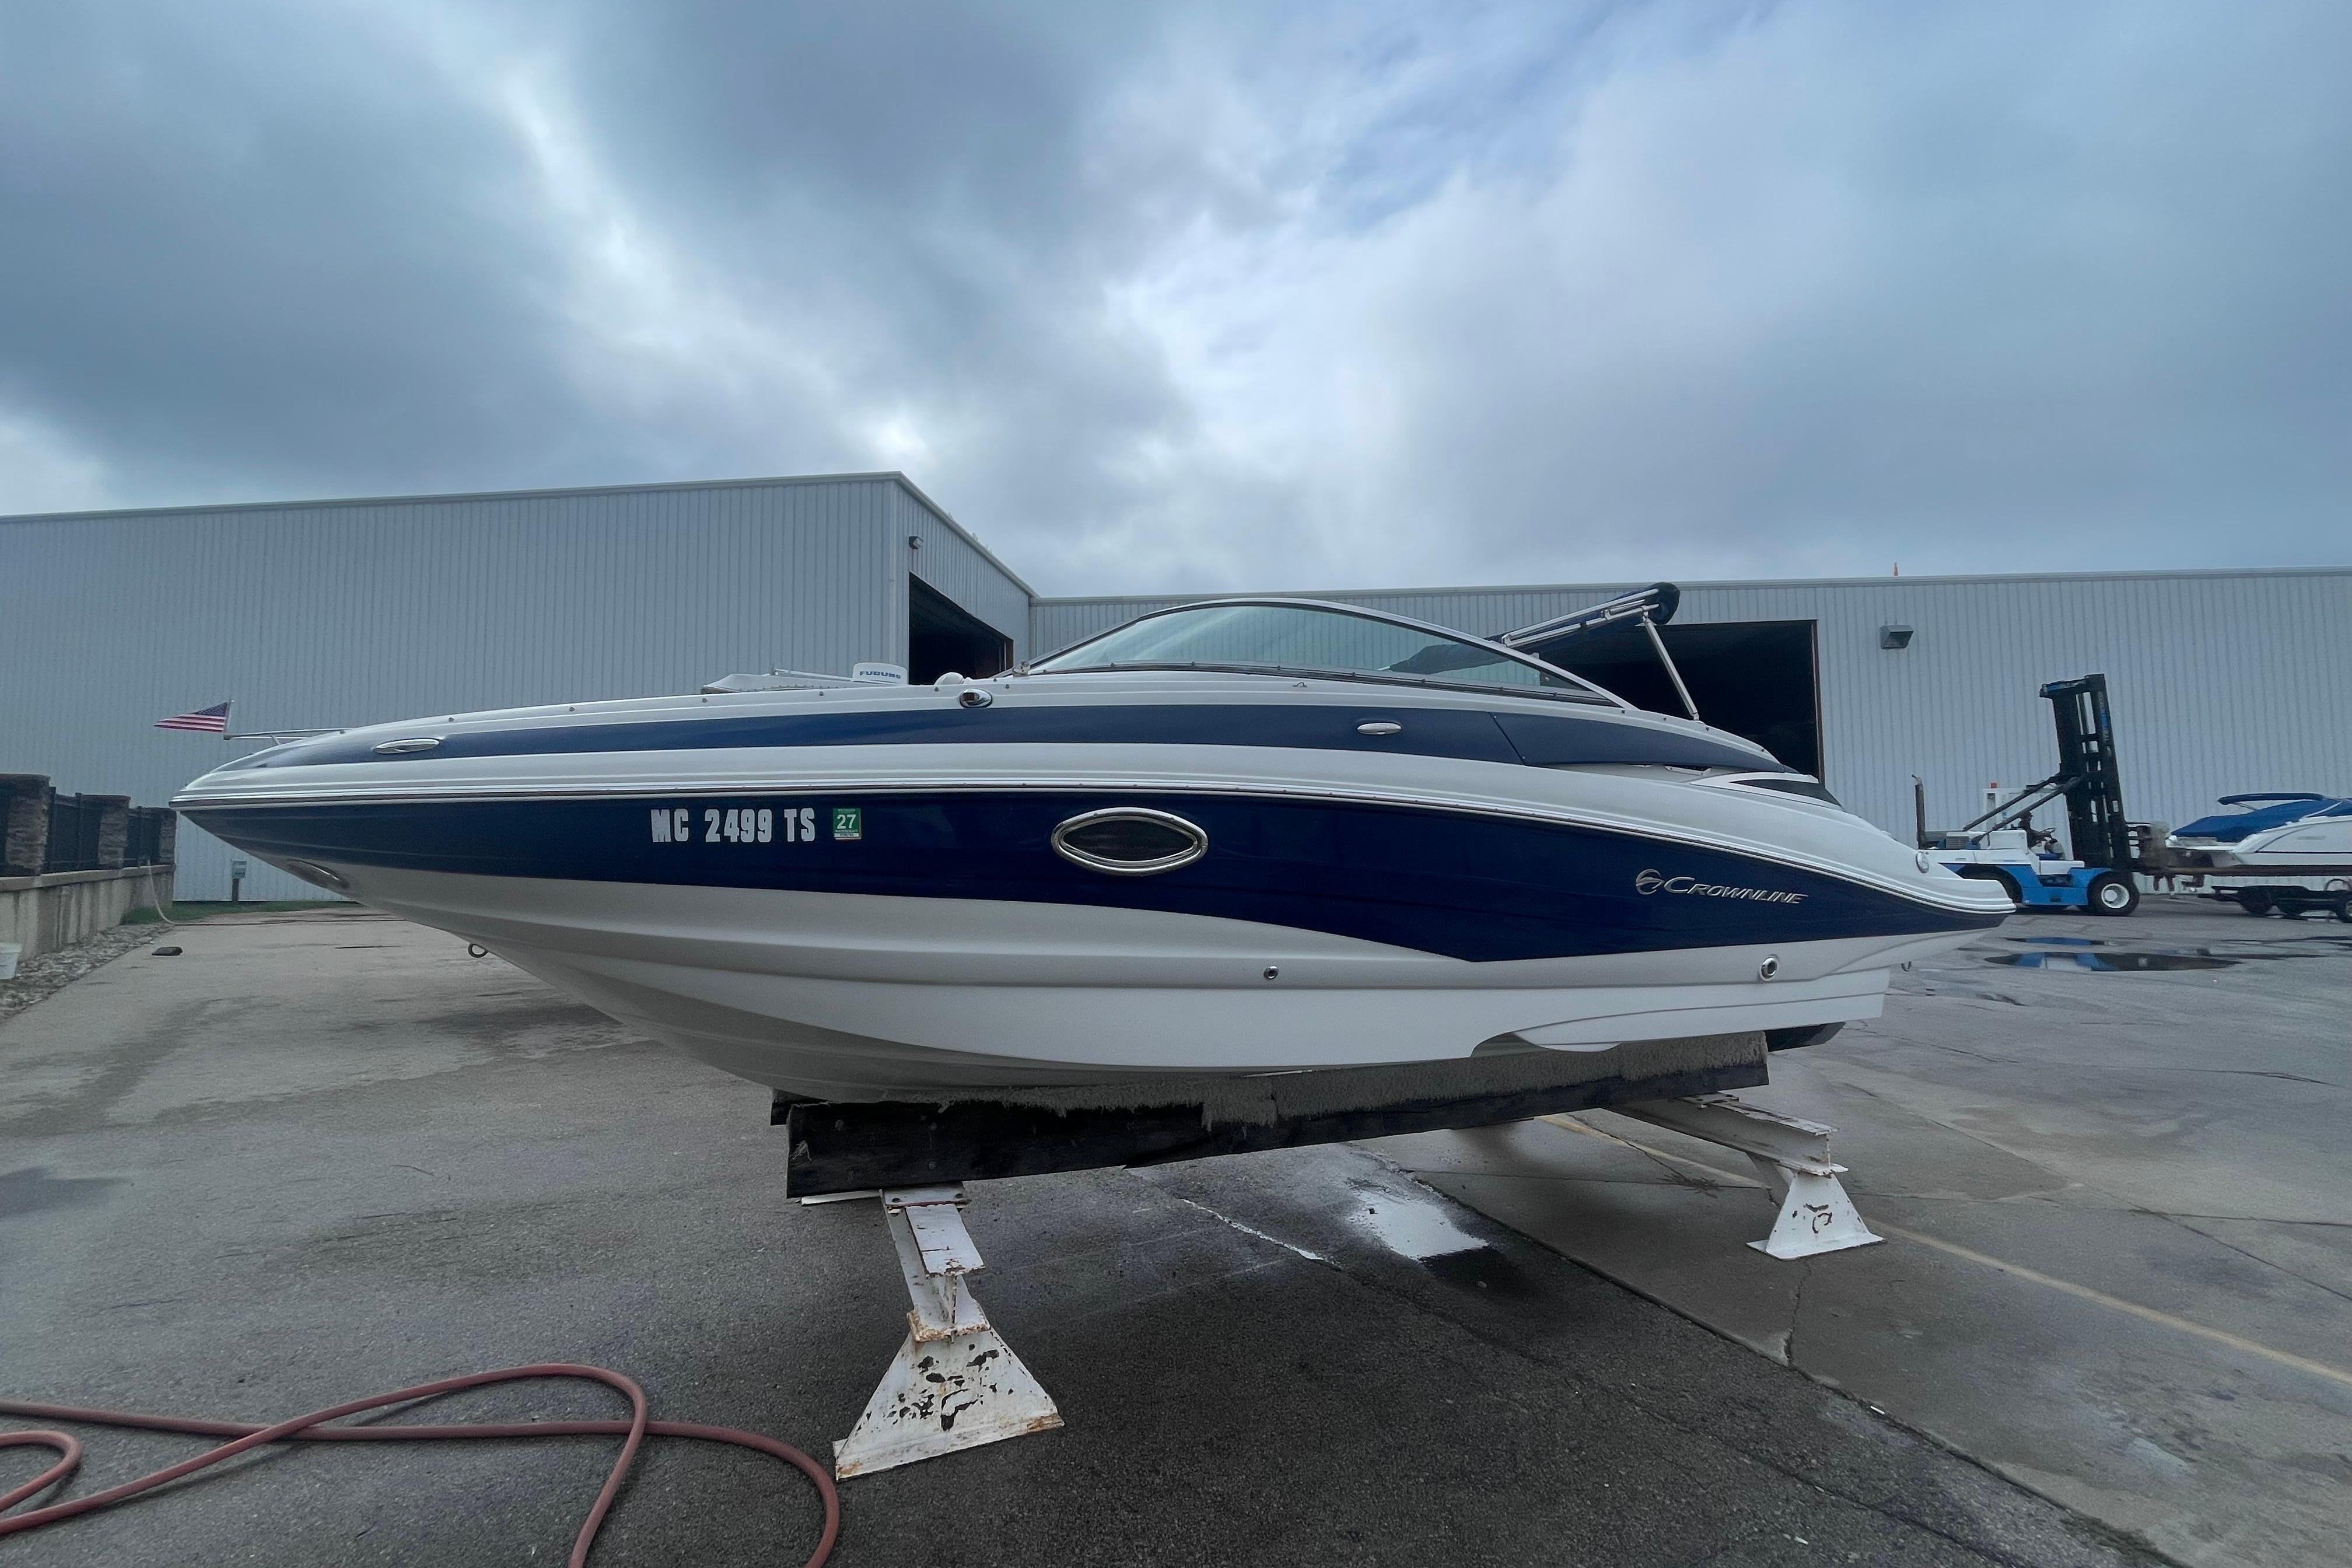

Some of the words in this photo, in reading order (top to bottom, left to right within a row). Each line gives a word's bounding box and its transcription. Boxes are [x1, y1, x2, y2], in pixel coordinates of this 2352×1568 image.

[859, 671, 901, 679] FURUNO
[650, 808, 689, 842] MC
[705, 809, 772, 842] 2499
[784, 807, 816, 842] TS
[836, 814, 856, 829] 27
[1664, 876, 1808, 904] CROWNLINE
